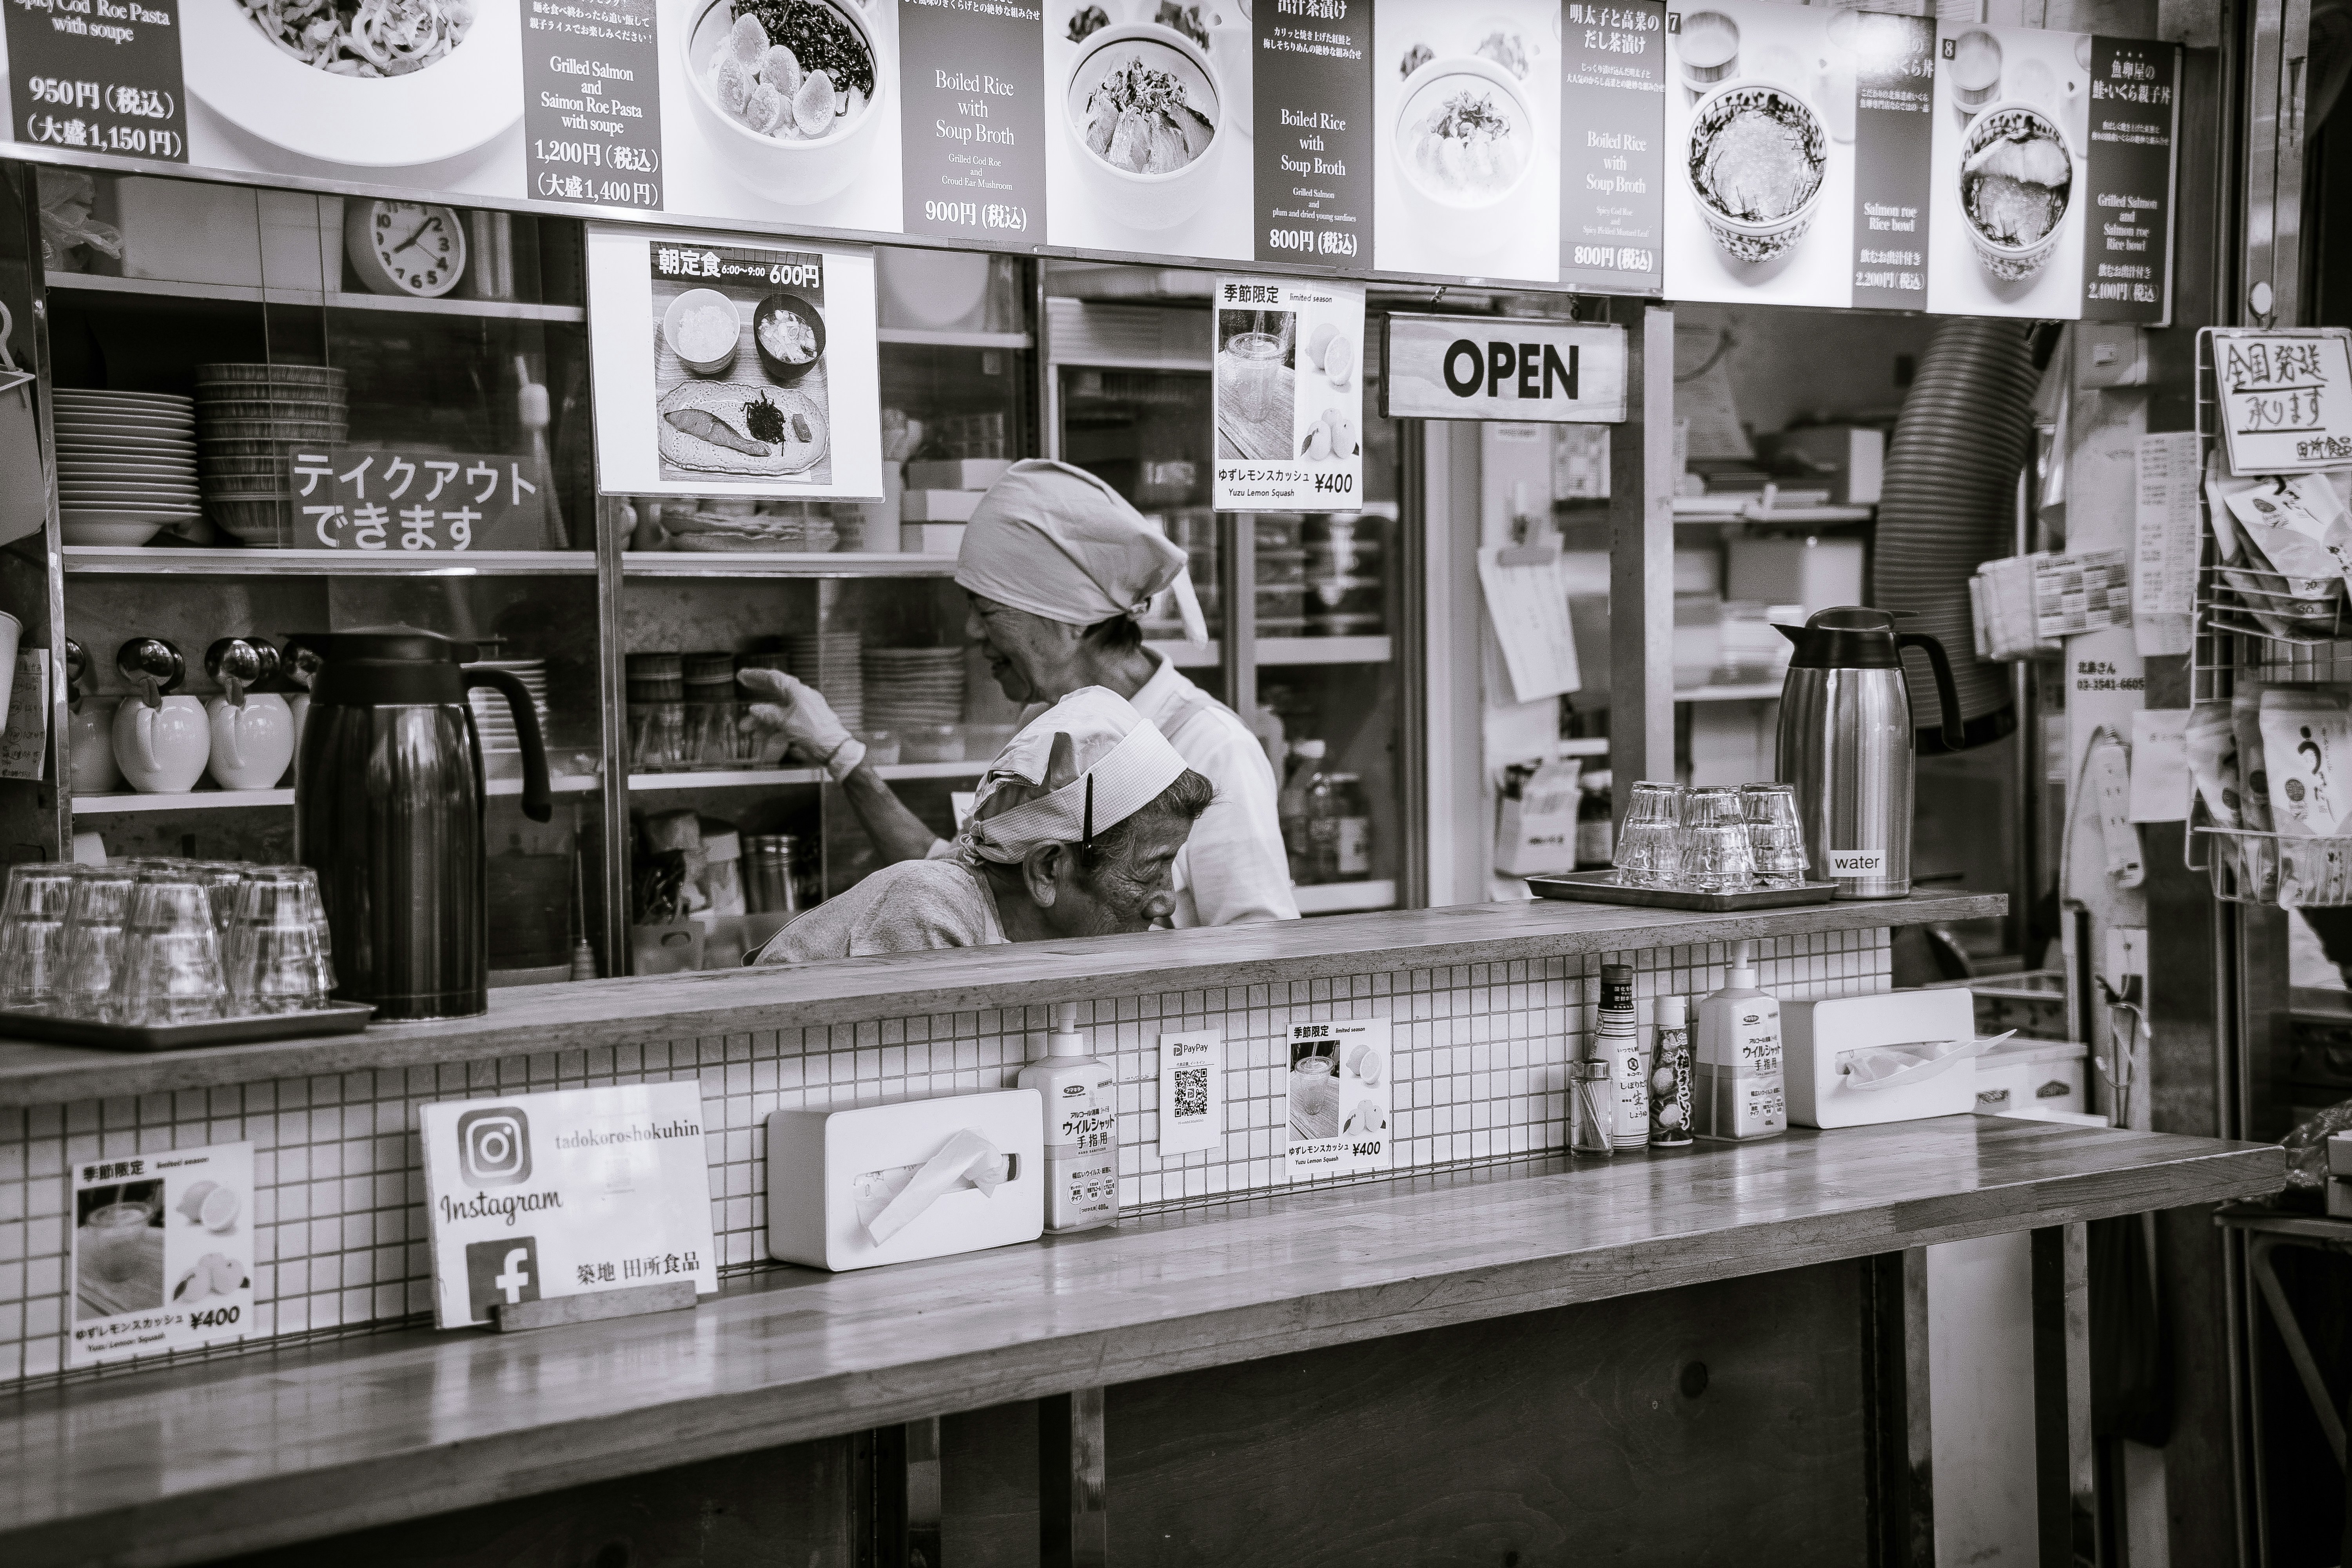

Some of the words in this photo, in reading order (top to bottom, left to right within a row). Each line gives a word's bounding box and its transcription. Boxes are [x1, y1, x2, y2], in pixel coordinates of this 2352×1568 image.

[15, 0, 53, 13] picy
[57, 0, 91, 13] Cod
[97, 0, 128, 19] Roe
[129, 3, 170, 25] Pasta
[1569, 4, 1660, 31] 明太子と高菜の
[52, 15, 87, 35] with
[89, 22, 134, 44] soupe
[1670, 15, 1679, 31] 7
[1584, 29, 1646, 54] だし茶漬け
[1945, 40, 1953, 57] 8
[550, 56, 590, 75] Grilled
[592, 61, 634, 81] Salmon
[581, 80, 602, 95] and
[935, 70, 980, 93] Boiled
[983, 75, 1014, 96] Rice
[541, 91, 584, 111] Saimon
[586, 96, 610, 114] Roe
[611, 100, 643, 118] Pasta
[957, 99, 989, 118] with
[561, 114, 588, 130] with
[590, 120, 624, 137] soupe
[1280, 108, 1317, 129] Boiled
[1320, 113, 1346, 131] Rice
[935, 119, 972, 145] Soup
[975, 123, 1015, 145] Broth
[1587, 131, 1621, 149] Boiled
[1623, 134, 1647, 151] Rice
[1299, 134, 1324, 151] with
[948, 153, 971, 164] Grilled
[973, 156, 987, 165] Cod
[988, 157, 1002, 167] Roe
[1281, 155, 1311, 177] Soup
[1313, 158, 1346, 176] Broth
[1603, 154, 1627, 171] with
[970, 168, 982, 176] and
[942, 175, 963, 186] Croud
[964, 178, 976, 187] Ear
[978, 179, 1013, 190] Mushroom
[1586, 172, 1614, 195] Soup
[1615, 176, 1646, 194] Broth
[1293, 187, 1312, 197] Grilled
[1313, 189, 1335, 199] Salmon
[1272, 207, 1287, 218] plum
[1300, 210, 1315, 219] dried
[1316, 214, 1333, 222] young
[1334, 213, 1357, 222] sardines
[1864, 201, 1900, 217] Salmon
[1901, 207, 1918, 218] roe
[1869, 217, 1891, 231] Rice
[1892, 218, 1915, 232] bowl
[659, 248, 721, 278] 朝定食
[769, 264, 820, 289] 600円
[410, 274, 423, 289] 6
[1224, 284, 1279, 304] 季節限定
[1289, 293, 1311, 302] limited
[1313, 295, 1332, 303] season
[1443, 339, 1579, 400] OPEN
[294, 454, 536, 506] テイクアウト
[1218, 468, 1309, 482] ゆずレモンスカッシュ
[1315, 473, 1352, 494] ¥400
[1229, 488, 1245, 497] Yuzu
[1247, 488, 1269, 497] Lemon
[1271, 489, 1294, 498] Squash
[302, 503, 482, 551] できます
[1835, 855, 1880, 869] water
[1294, 1025, 1329, 1039] 季節限定
[1184, 1044, 1208, 1054] PayPay
[1754, 1057, 1777, 1071] 手指用
[555, 1120, 699, 1149] tadokoroshokuhin
[1063, 1114, 1115, 1136] ウイルシャット
[1077, 1132, 1107, 1149] 手指用
[1289, 1143, 1349, 1156] ゆずレモンスカッシュ
[1352, 1142, 1381, 1156] ¥400
[1323, 1155, 1339, 1164] Squash
[440, 1191, 564, 1226] Instagram
[577, 1261, 616, 1286] 築地
[623, 1251, 699, 1280] 田所食品
[190, 1305, 241, 1330] ¥400
